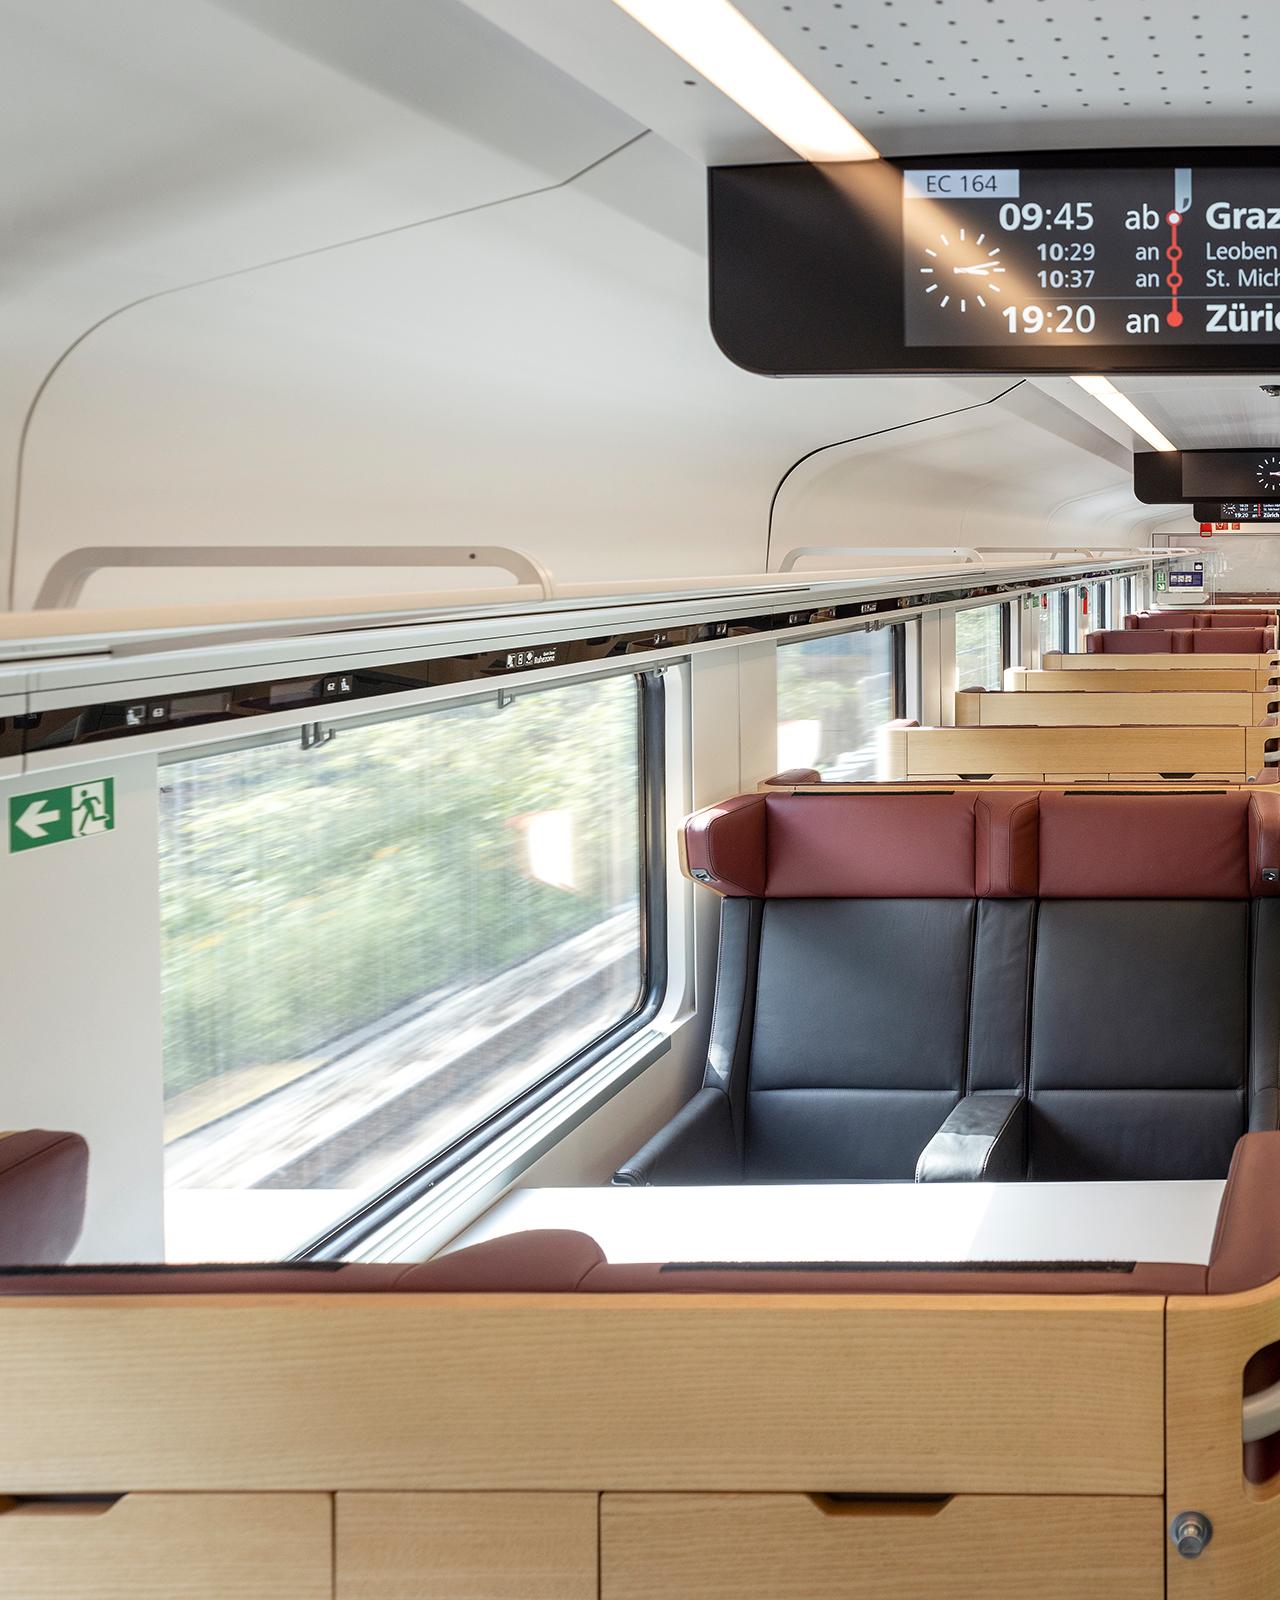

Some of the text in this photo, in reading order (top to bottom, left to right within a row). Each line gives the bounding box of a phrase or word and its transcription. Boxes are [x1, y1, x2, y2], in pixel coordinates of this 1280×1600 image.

[926, 175, 998, 193] EC 164
[999, 202, 1094, 232] 09:45
[1125, 204, 1160, 230] ab
[1036, 243, 1096, 262] 10:29
[1135, 246, 1160, 261] an
[1205, 241, 1279, 261] Leoben
[1036, 270, 1096, 289] 10:37
[1135, 273, 1160, 287] an
[1205, 269, 1231, 288] St.
[1001, 304, 1096, 334] 19:20
[1125, 313, 1160, 333] an
